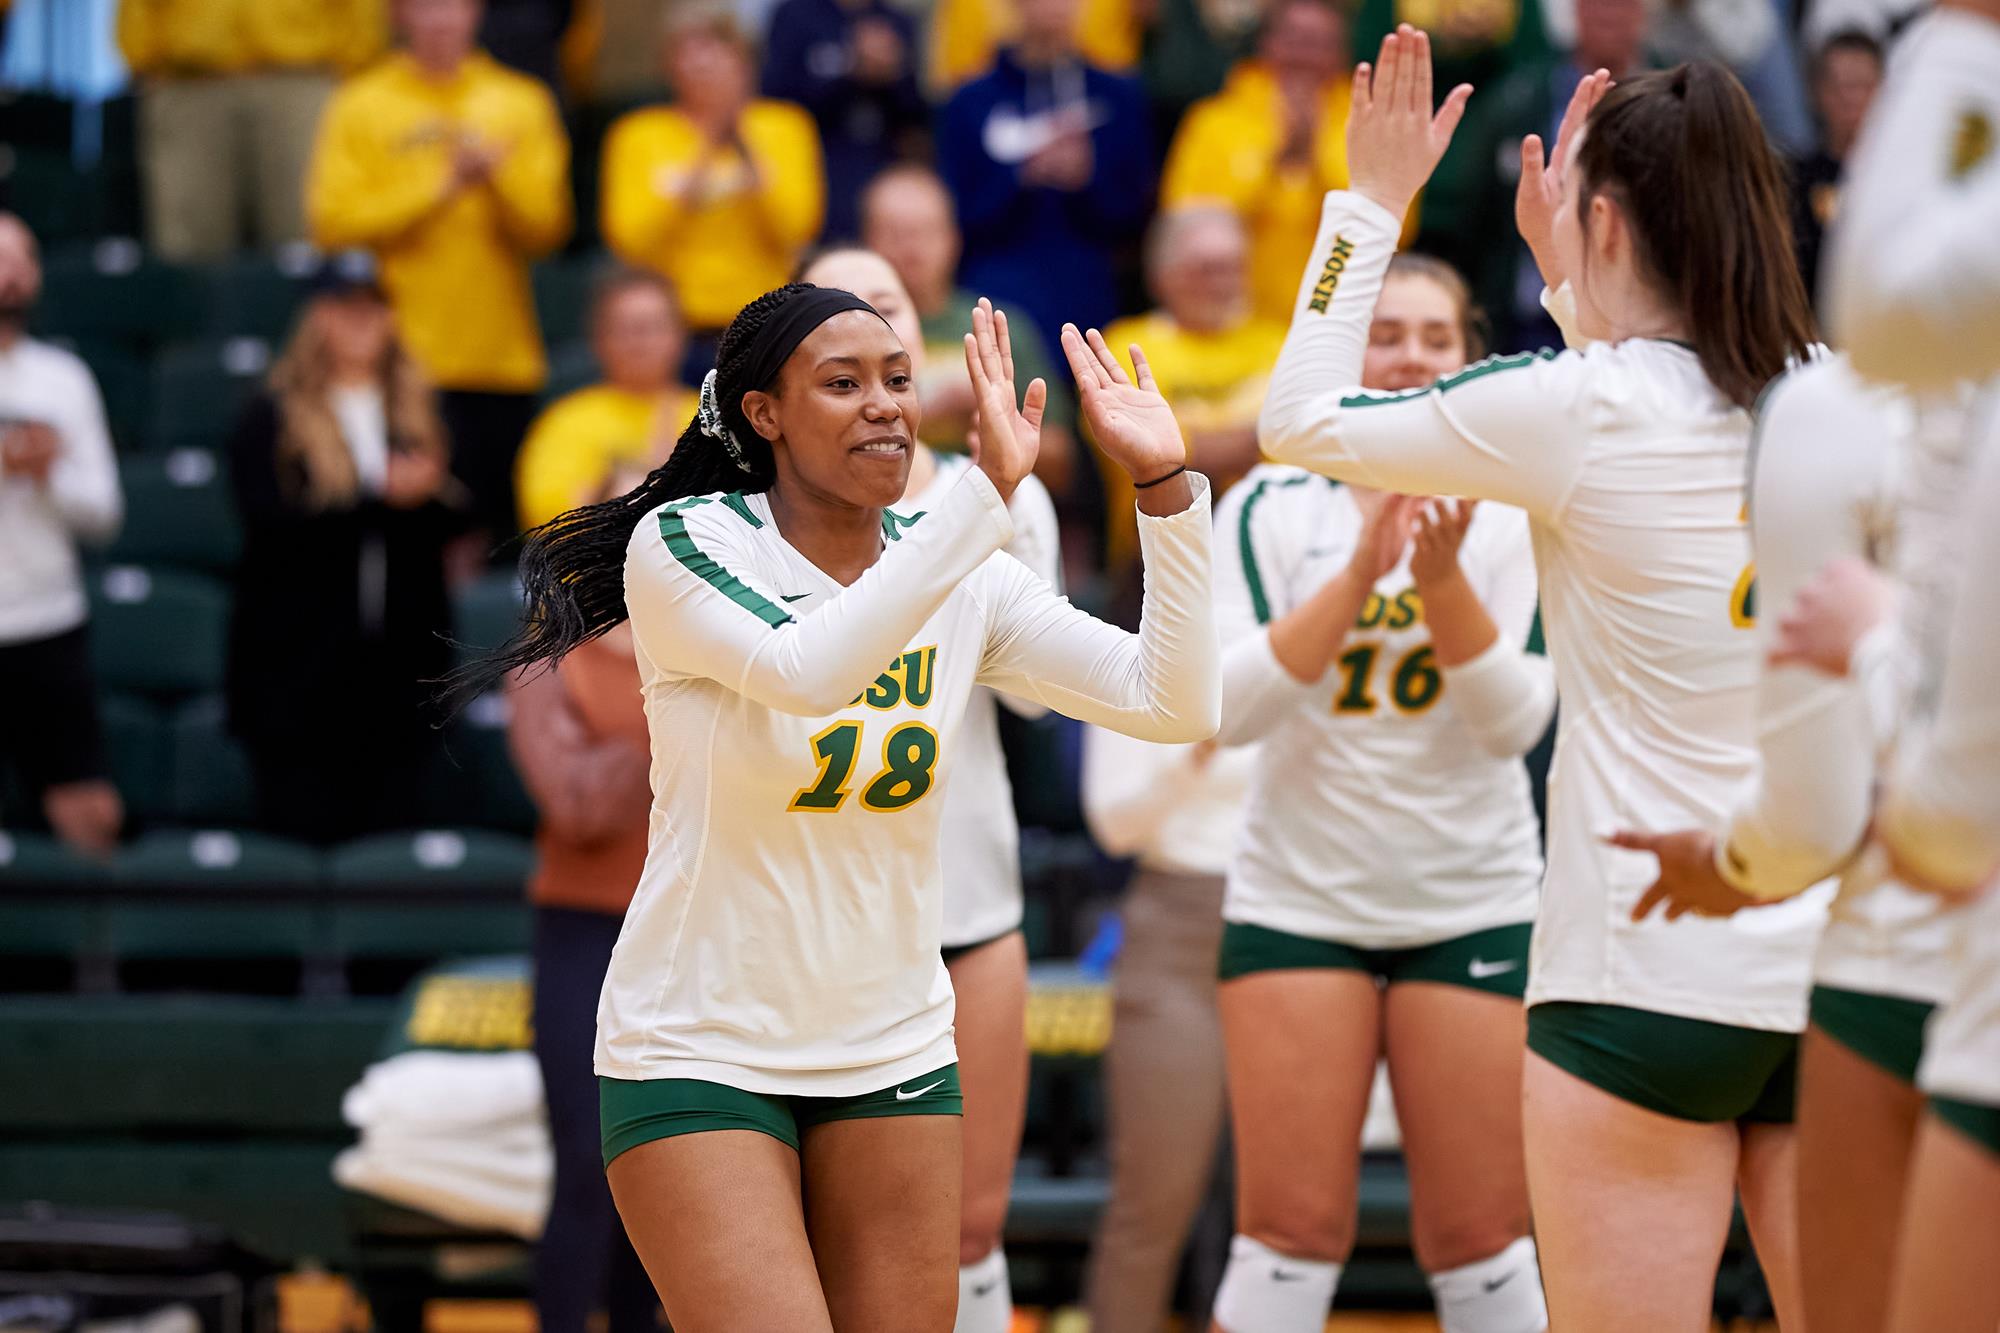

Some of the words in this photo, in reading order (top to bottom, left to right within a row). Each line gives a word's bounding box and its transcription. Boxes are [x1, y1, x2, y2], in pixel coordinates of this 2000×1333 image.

[1308, 233, 1354, 314] BISON
[848, 644, 938, 712] SU
[1332, 642, 1443, 716] 16
[786, 719, 940, 813] 18
